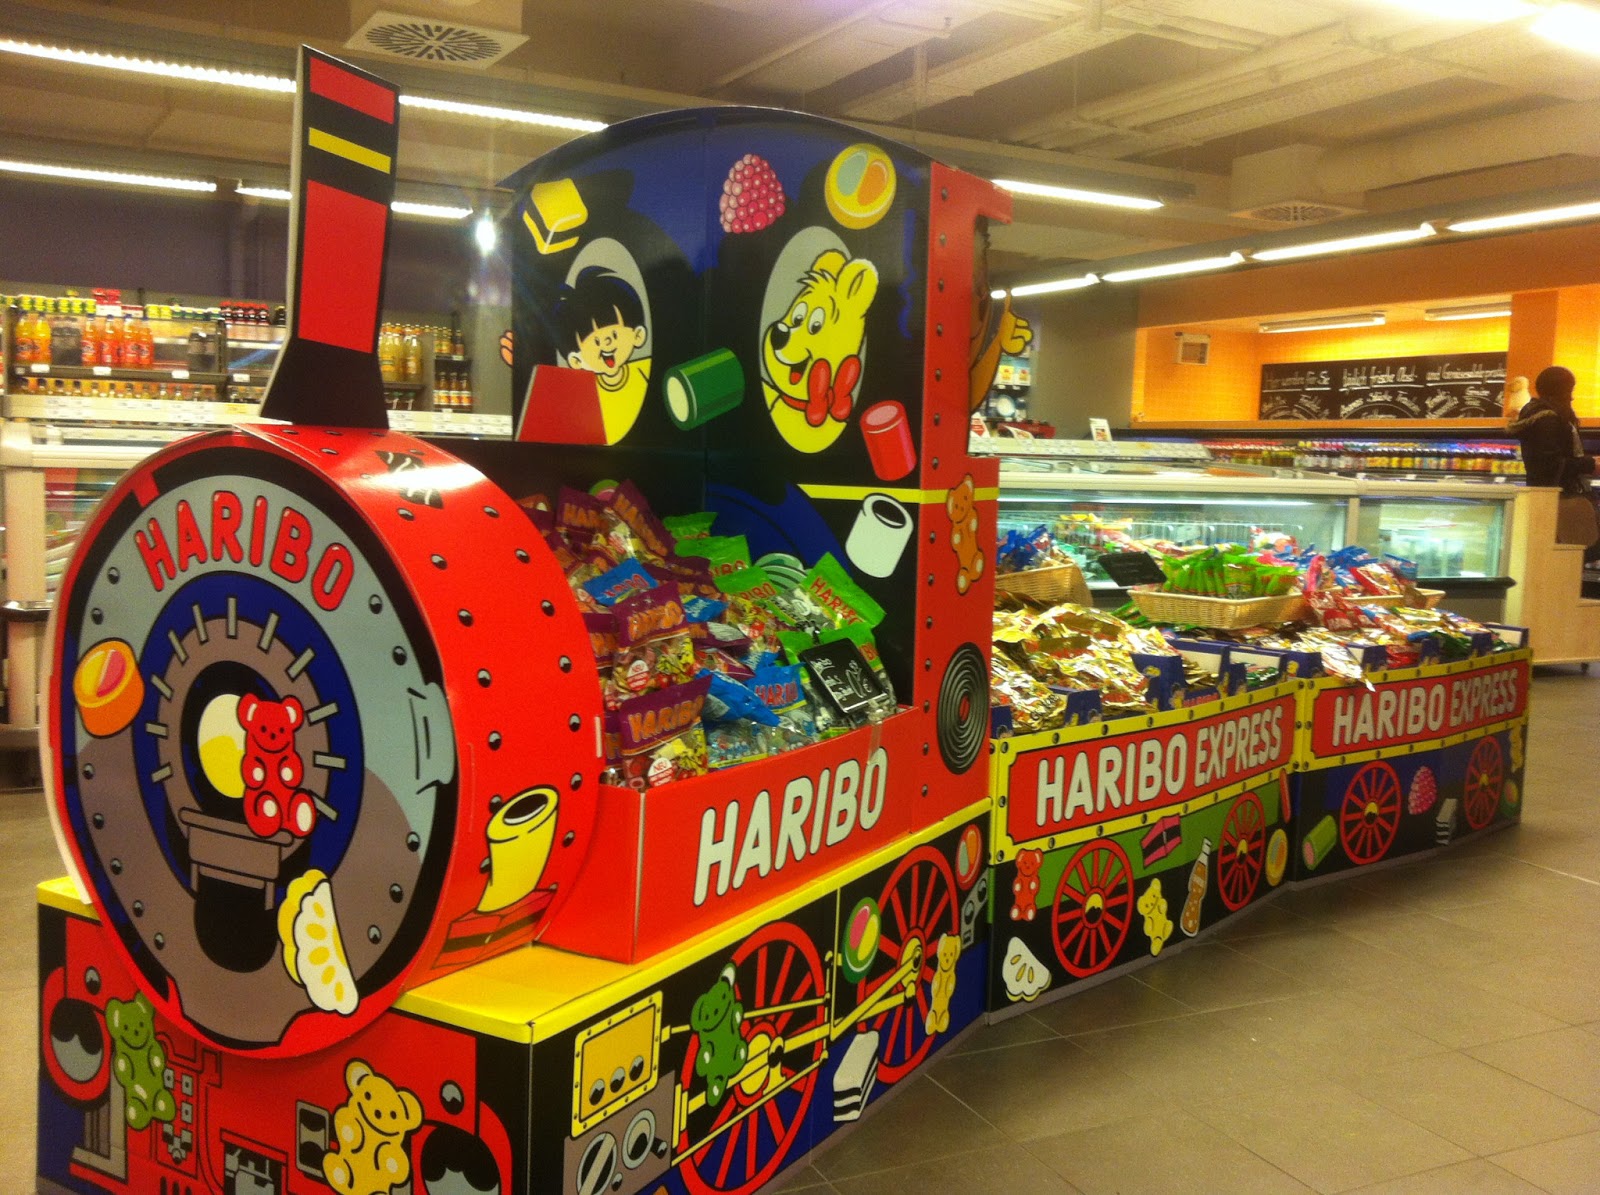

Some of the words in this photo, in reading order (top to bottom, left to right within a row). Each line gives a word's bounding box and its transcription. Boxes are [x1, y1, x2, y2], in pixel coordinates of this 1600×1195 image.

[135, 490, 355, 611] HARIBO
[1036, 733, 1188, 827] HARIBO
[1195, 705, 1283, 787] EXPRESS
[1332, 683, 1446, 747] HARIBO
[1450, 668, 1518, 727] EXPRESS
[693, 746, 888, 906] HARIBO
